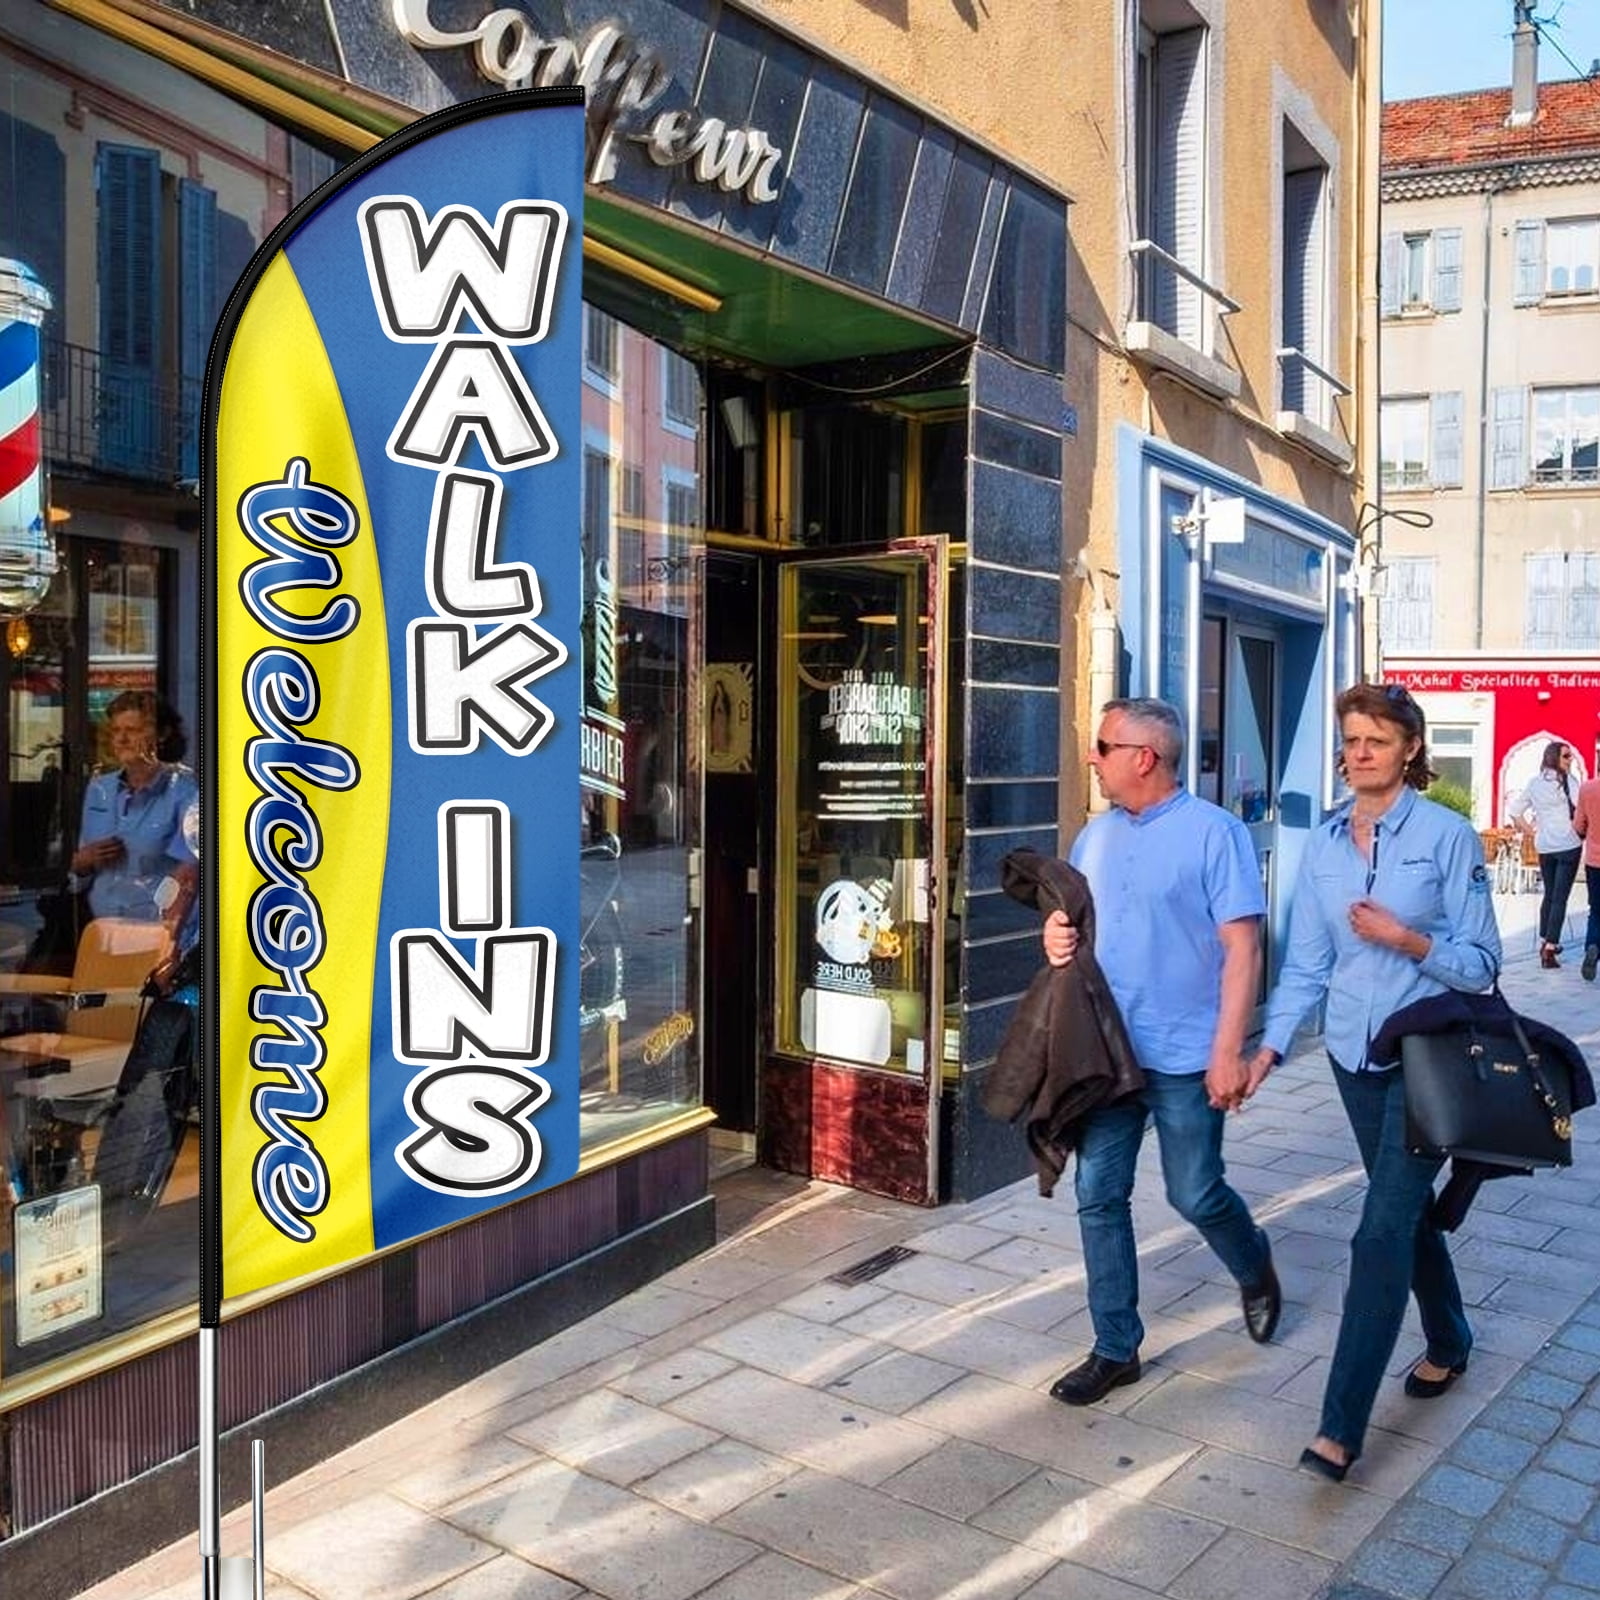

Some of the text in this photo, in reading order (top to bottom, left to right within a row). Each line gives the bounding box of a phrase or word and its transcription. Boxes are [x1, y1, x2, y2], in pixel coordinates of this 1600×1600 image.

[237, 457, 361, 1243] Welcome
[357, 195, 569, 1198] WALK INS
[580, 722, 624, 783] RBIER
[1382, 672, 1454, 688] aj-Mahal
